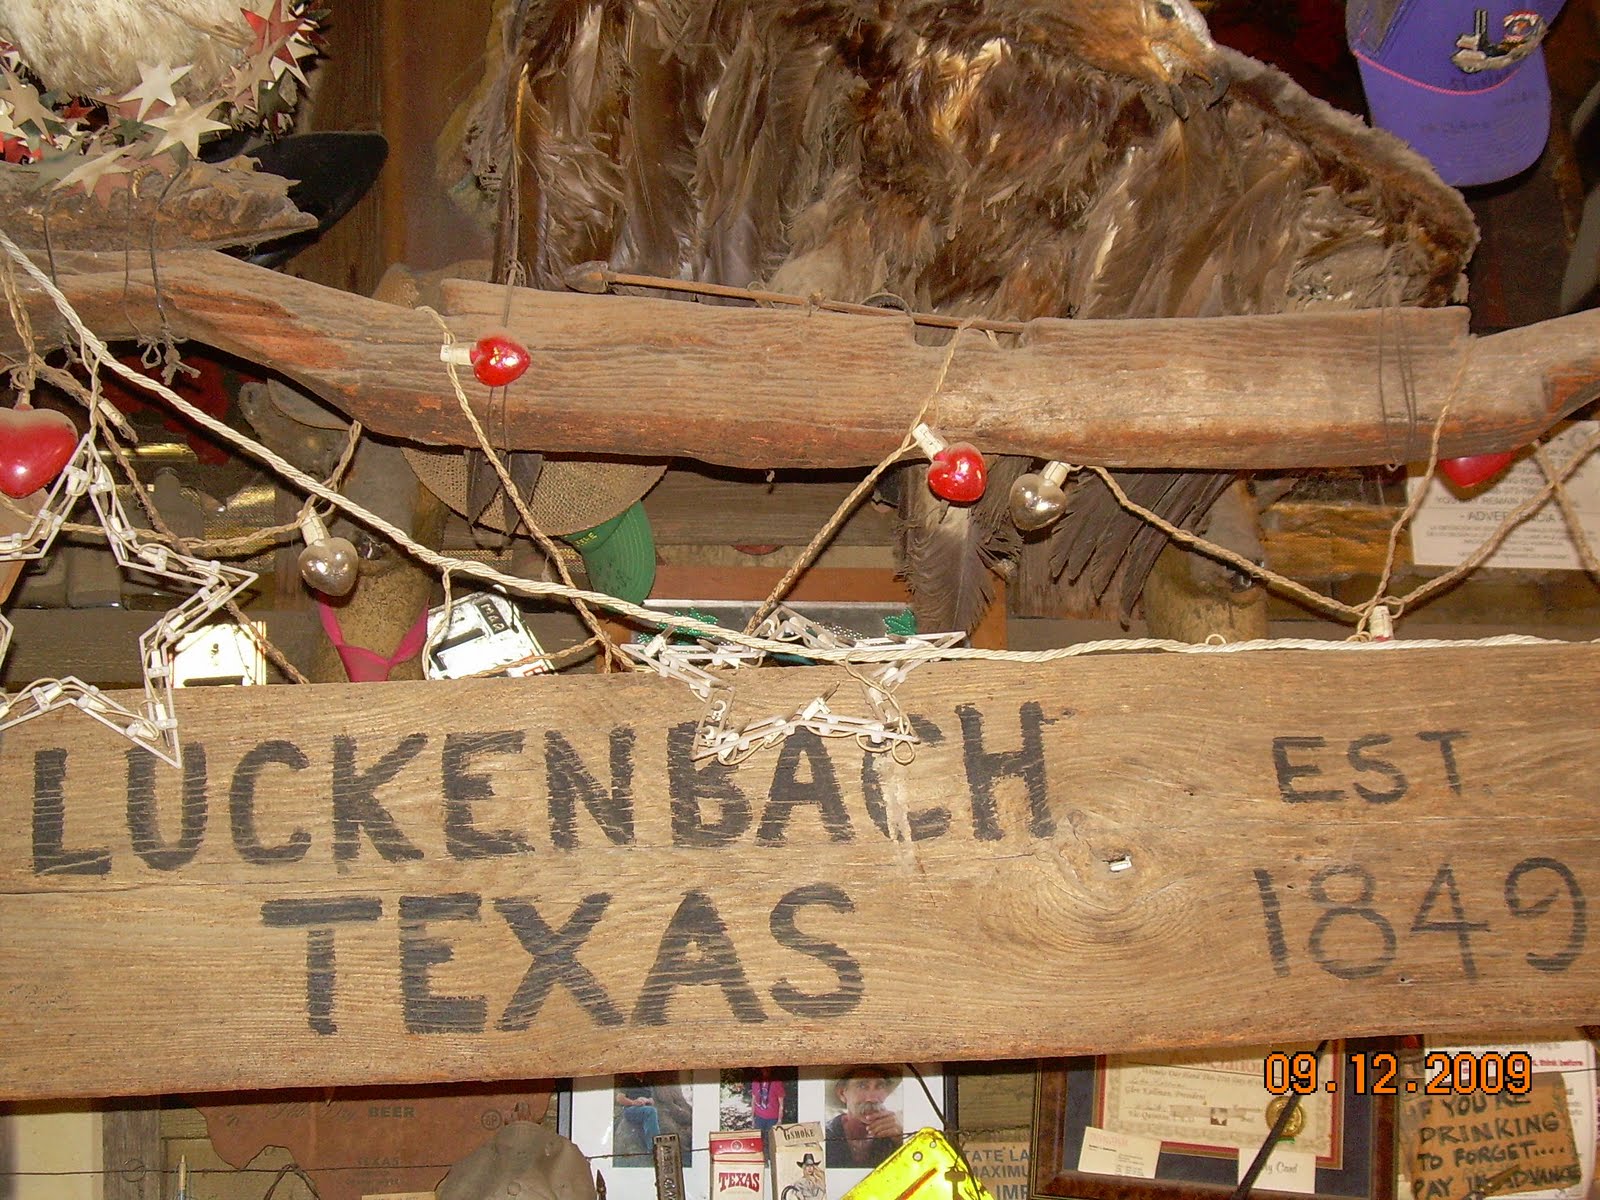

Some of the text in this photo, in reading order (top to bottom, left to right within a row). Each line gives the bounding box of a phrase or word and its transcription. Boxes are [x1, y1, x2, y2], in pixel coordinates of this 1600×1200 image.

[1272, 730, 1470, 804] EST
[32, 701, 1057, 875] LUCKENBACH
[1253, 856, 1587, 984] 1849
[260, 881, 866, 1035] TEXAS
[368, 1105, 416, 1119] BEER
[1440, 1089, 1532, 1118] YOURE
[1420, 1112, 1561, 1145] DRINKING
[963, 1149, 1030, 1162] TATE LA
[1417, 1152, 1443, 1171] TO
[718, 1172, 761, 1193] TEXAS
[973, 1165, 1029, 1178] MAXIMU
[996, 1184, 1029, 1200] IMP
[1413, 1177, 1453, 1200] PAY
